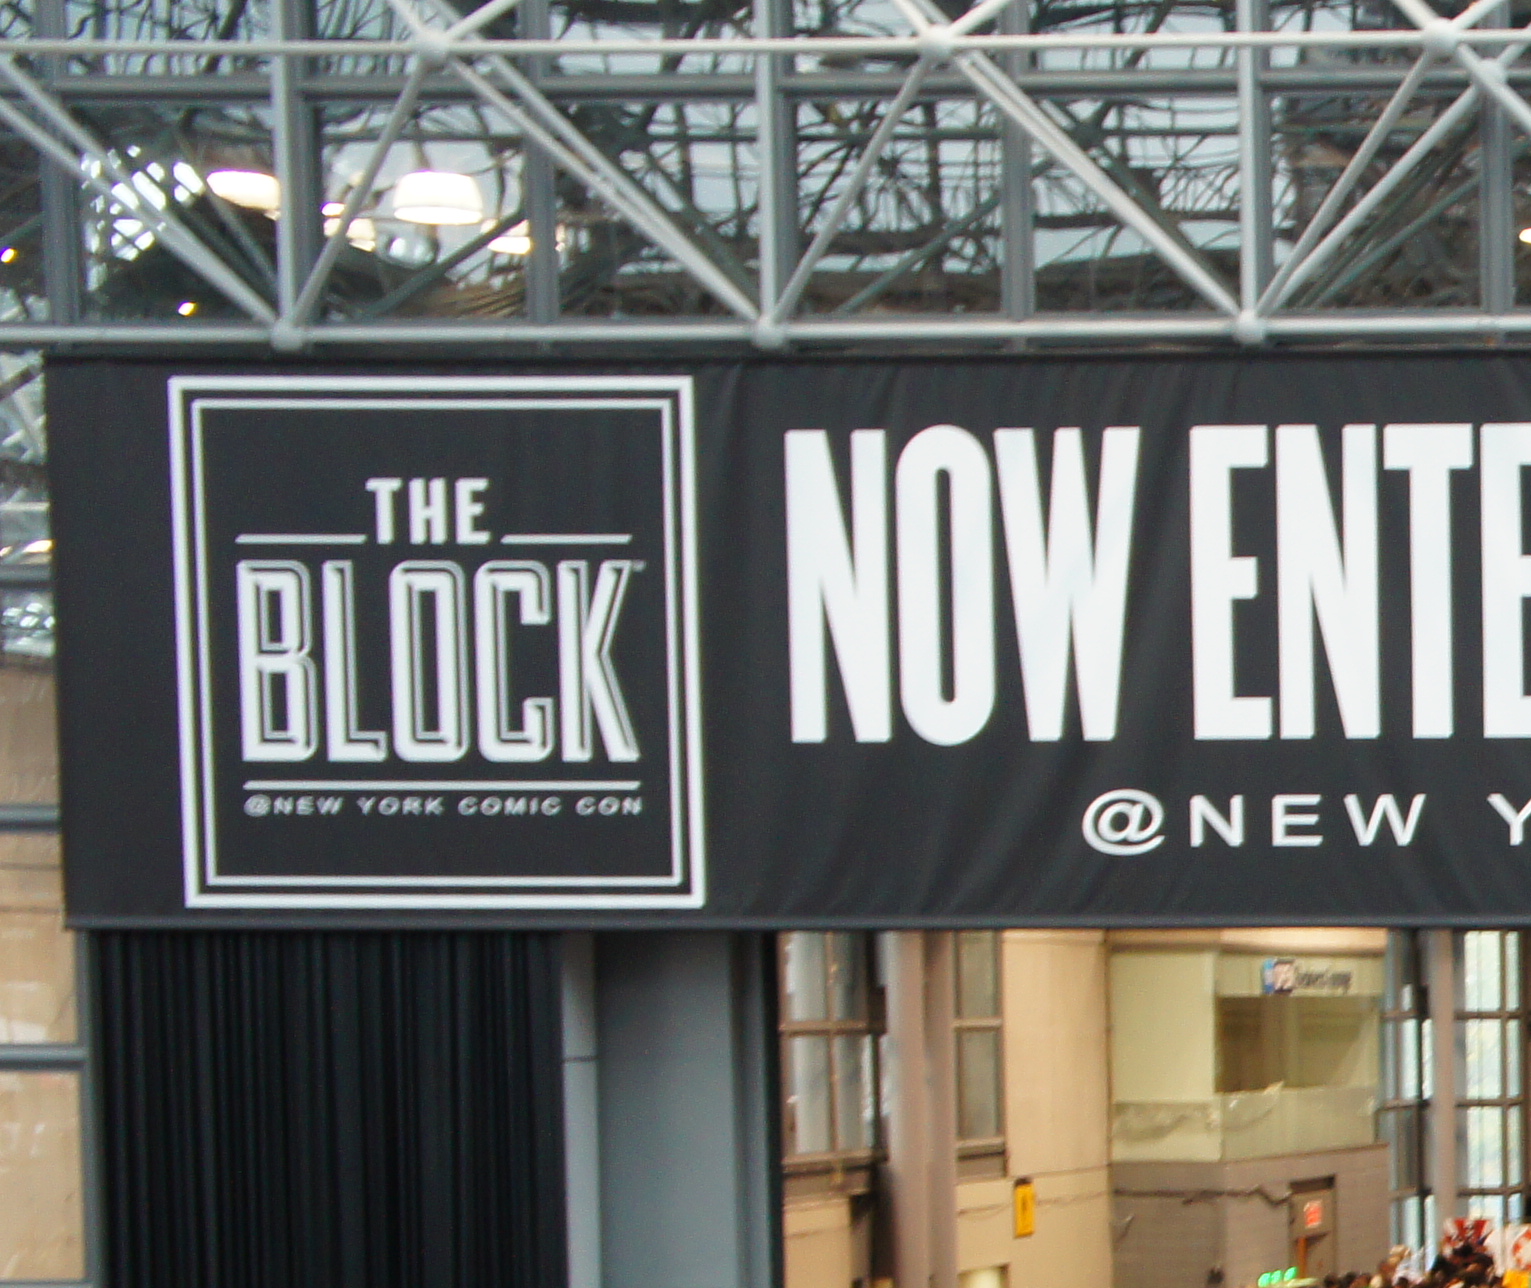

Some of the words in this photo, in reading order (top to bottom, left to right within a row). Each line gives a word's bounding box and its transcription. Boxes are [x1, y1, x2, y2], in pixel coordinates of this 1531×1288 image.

[365, 477, 492, 544] THE
[784, 423, 1142, 746] NOW
[243, 793, 344, 818] @NEW
[356, 796, 446, 817] YORK
[457, 795, 563, 817] COMIC
[574, 795, 644, 817] CON
[1081, 788, 1427, 857] @NEW
